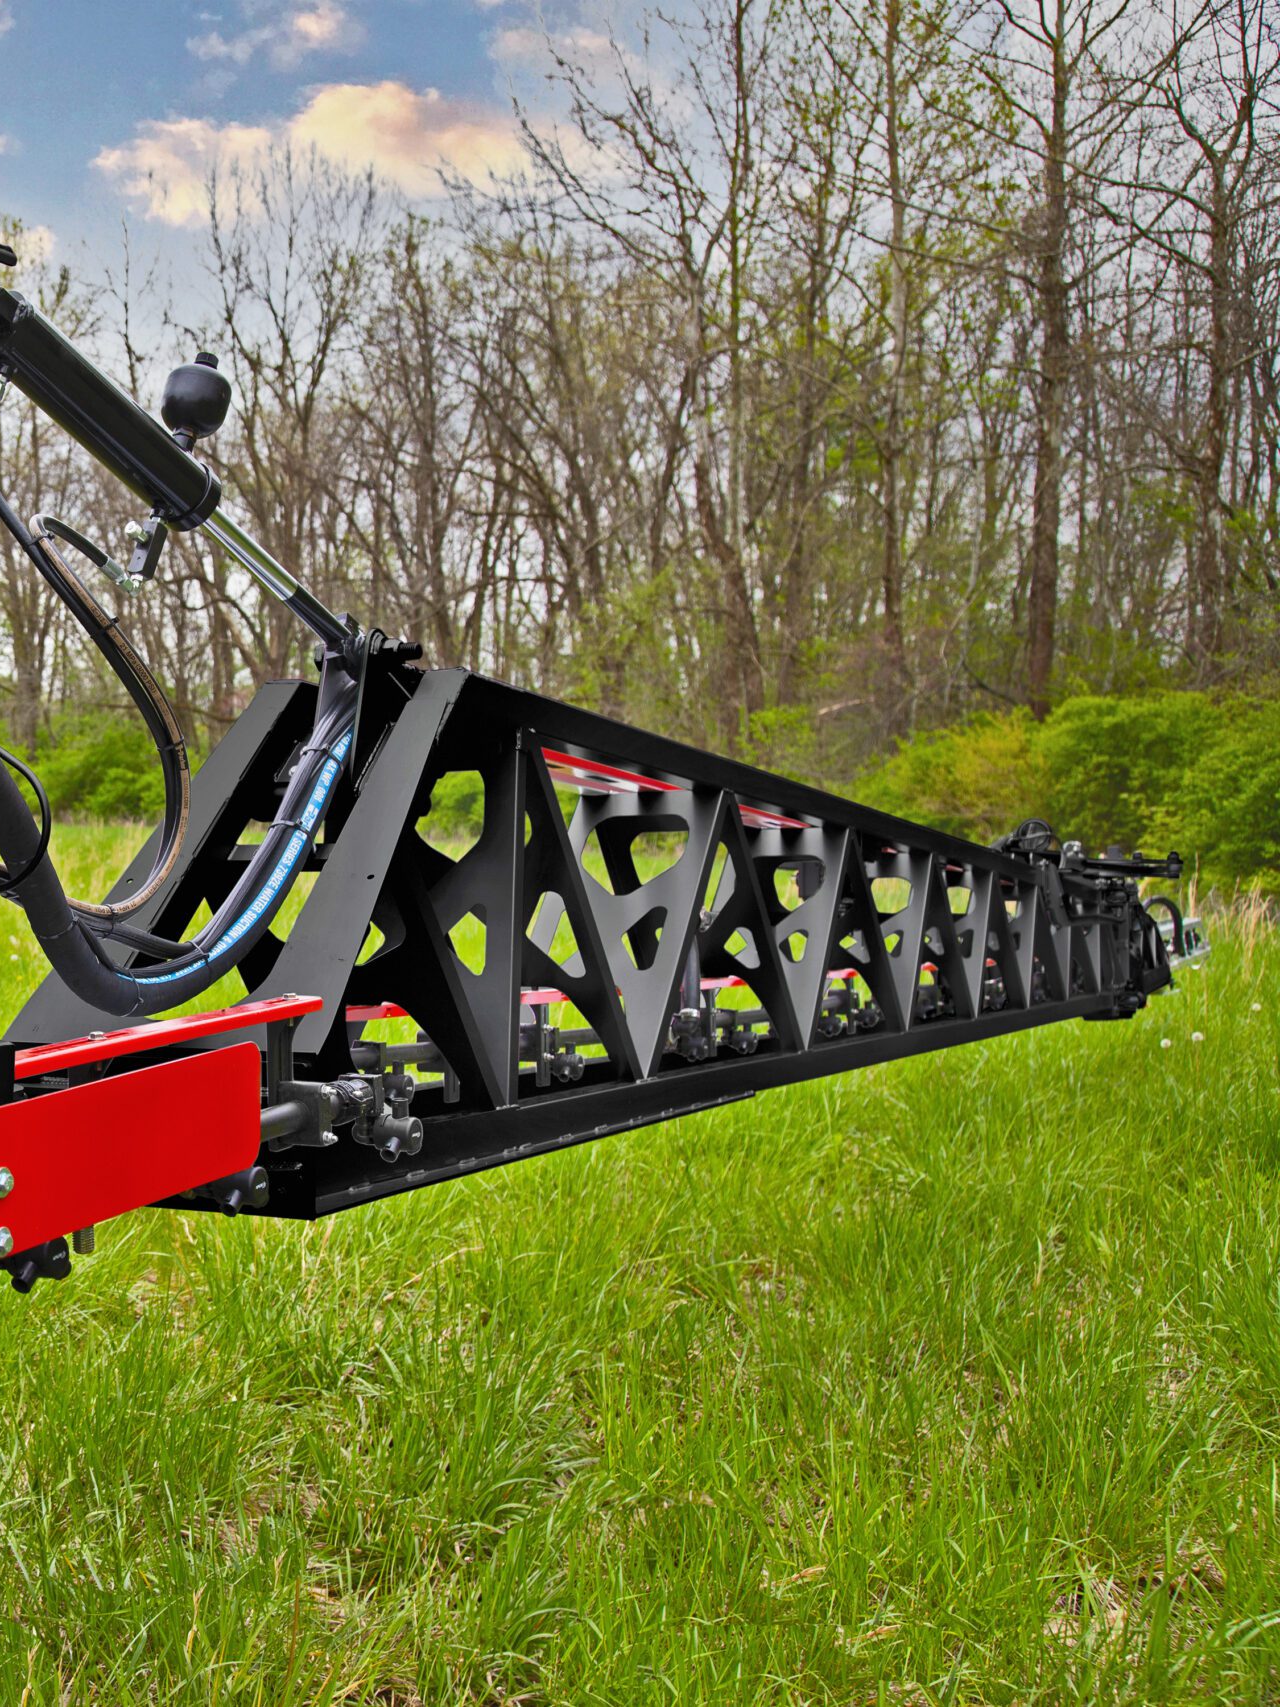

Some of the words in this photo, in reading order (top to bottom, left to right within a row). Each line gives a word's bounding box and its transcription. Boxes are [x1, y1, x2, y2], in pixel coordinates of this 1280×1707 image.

[282, 837, 303, 866] SERIES
[268, 865, 289, 890] 7392E
[253, 887, 275, 913] WATER
[228, 911, 258, 939] SUCTION
